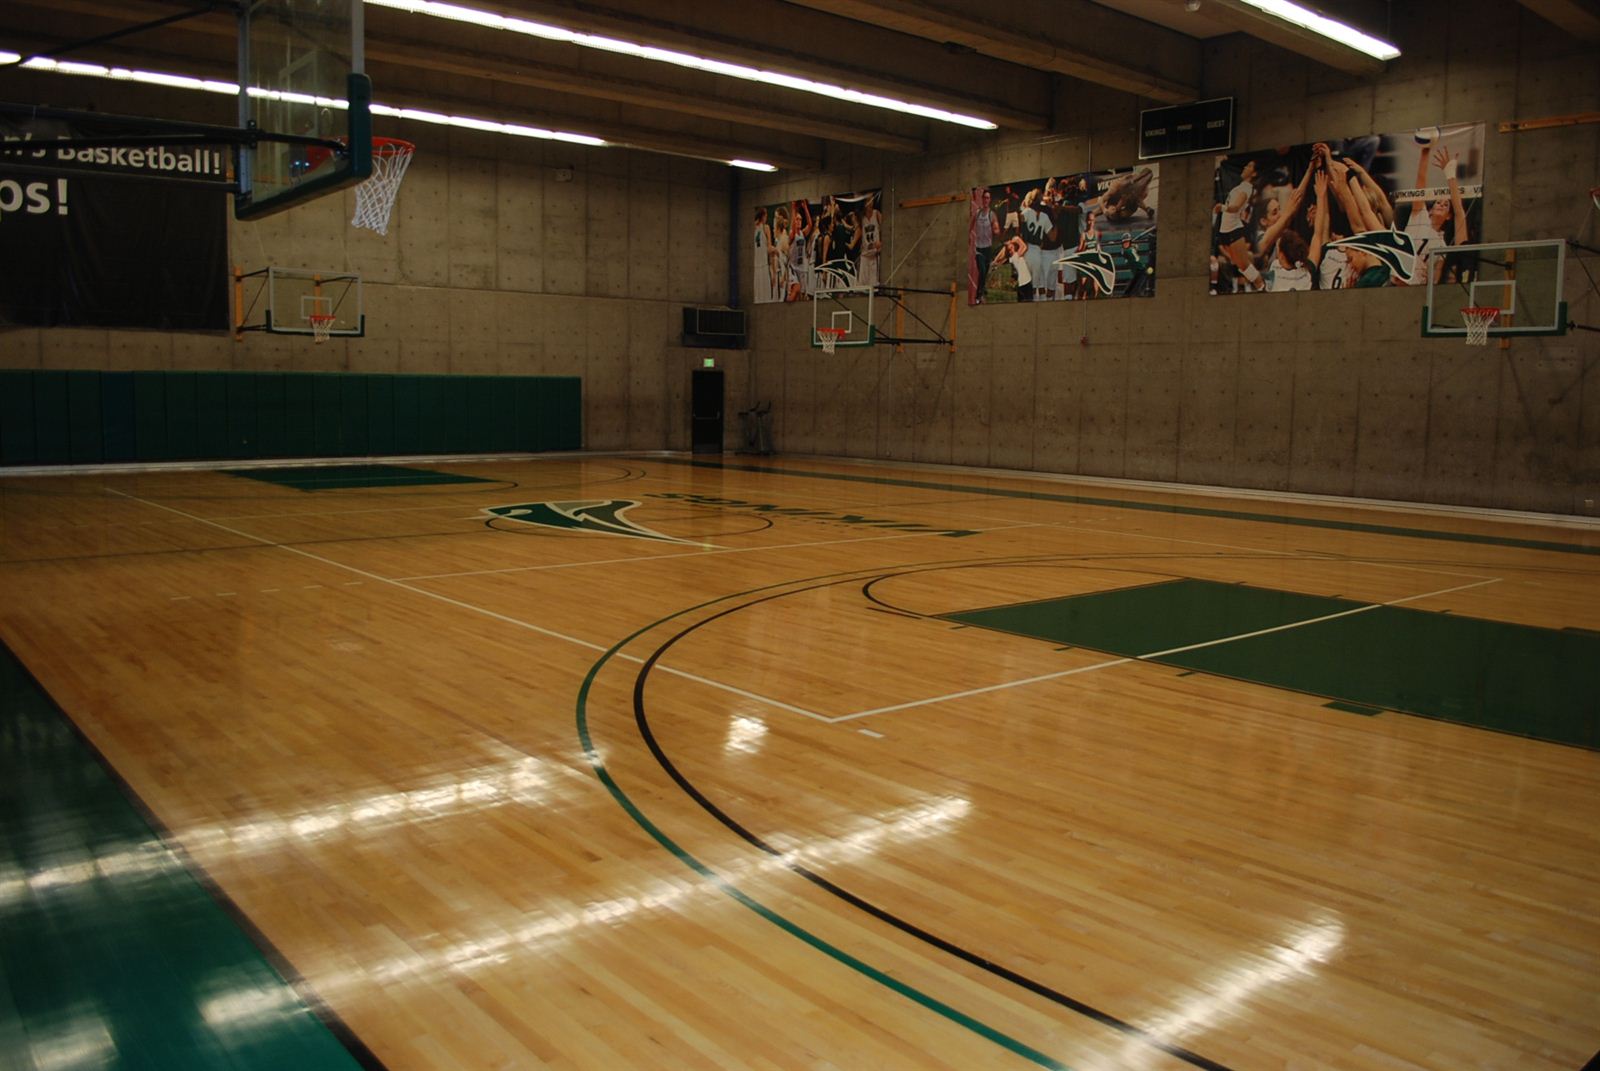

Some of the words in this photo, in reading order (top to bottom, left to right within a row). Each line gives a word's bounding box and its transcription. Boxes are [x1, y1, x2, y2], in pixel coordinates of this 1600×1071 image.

[57, 135, 222, 175] Basketball!
[1394, 189, 1425, 199] VIKINGS
[1332, 267, 1342, 290] 6
